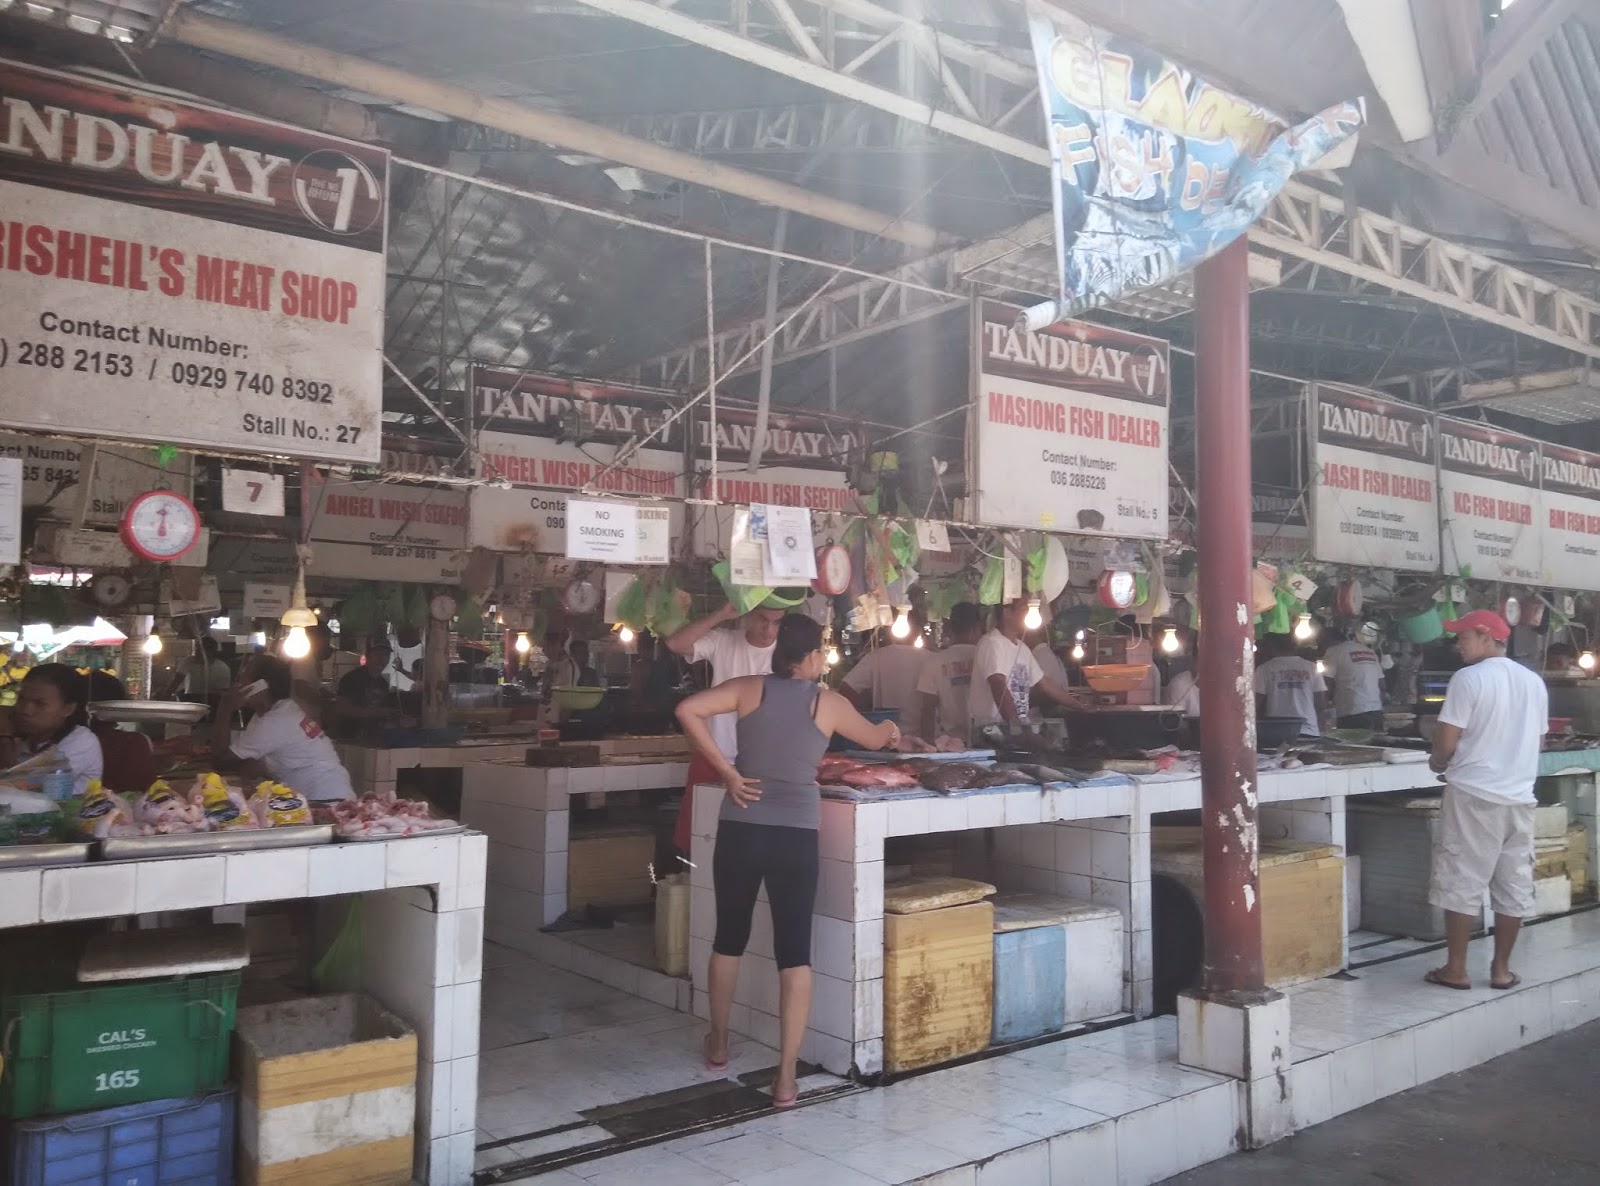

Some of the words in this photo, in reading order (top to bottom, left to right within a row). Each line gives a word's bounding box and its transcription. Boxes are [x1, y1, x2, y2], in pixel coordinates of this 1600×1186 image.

[0, 97, 291, 206] NDUAY
[1179, 153, 1234, 215] DE
[0, 220, 185, 298] ISHEIL'S
[195, 254, 275, 312] MEAT
[281, 270, 357, 325] SHOP
[40, 311, 140, 344] Contact
[148, 326, 249, 359] Number:
[984, 320, 1131, 384] TANDUAY
[18, 341, 65, 370] 288
[74, 348, 134, 377] 2153
[172, 362, 227, 389] 0929
[235, 370, 274, 396] 740
[281, 376, 333, 404] 8392
[242, 413, 286, 437] Stall
[292, 420, 329, 442] No.:
[336, 425, 361, 444] 27
[988, 392, 1066, 434] MASIONG
[1069, 406, 1104, 440] FISH
[1108, 413, 1161, 448] DEALER
[1320, 401, 1411, 447] TANDUAY
[1042, 449, 1079, 468] Contact
[1079, 454, 1118, 472] Number:
[1441, 434, 1519, 472] TANDUAY
[480, 452, 539, 484] ANGEL
[541, 458, 591, 490] WISH
[625, 467, 676, 496] STATION
[1050, 470, 1067, 486] 036
[1323, 461, 1360, 492] JASH
[1362, 467, 1390, 496] FISH
[1391, 473, 1432, 503] DEALER
[246, 481, 262, 503] 7
[530, 496, 567, 512] Conta
[772, 482, 801, 507] FISH
[325, 493, 375, 519] ANGEL
[379, 499, 423, 522] WISH
[595, 510, 610, 520] NO
[1117, 503, 1136, 518] Stall
[1152, 508, 1158, 520] 5
[1357, 507, 1380, 519] Contact
[1454, 491, 1471, 515] KC
[1473, 495, 1496, 519] FISH
[1498, 499, 1533, 526] DEALER
[579, 526, 624, 538] SMOKING
[1567, 511, 1586, 533] FISH
[928, 529, 938, 545] 6
[98, 1029, 146, 1044] CAL'S
[122, 1040, 157, 1050] CHICKEN
[95, 1069, 140, 1092] 165
